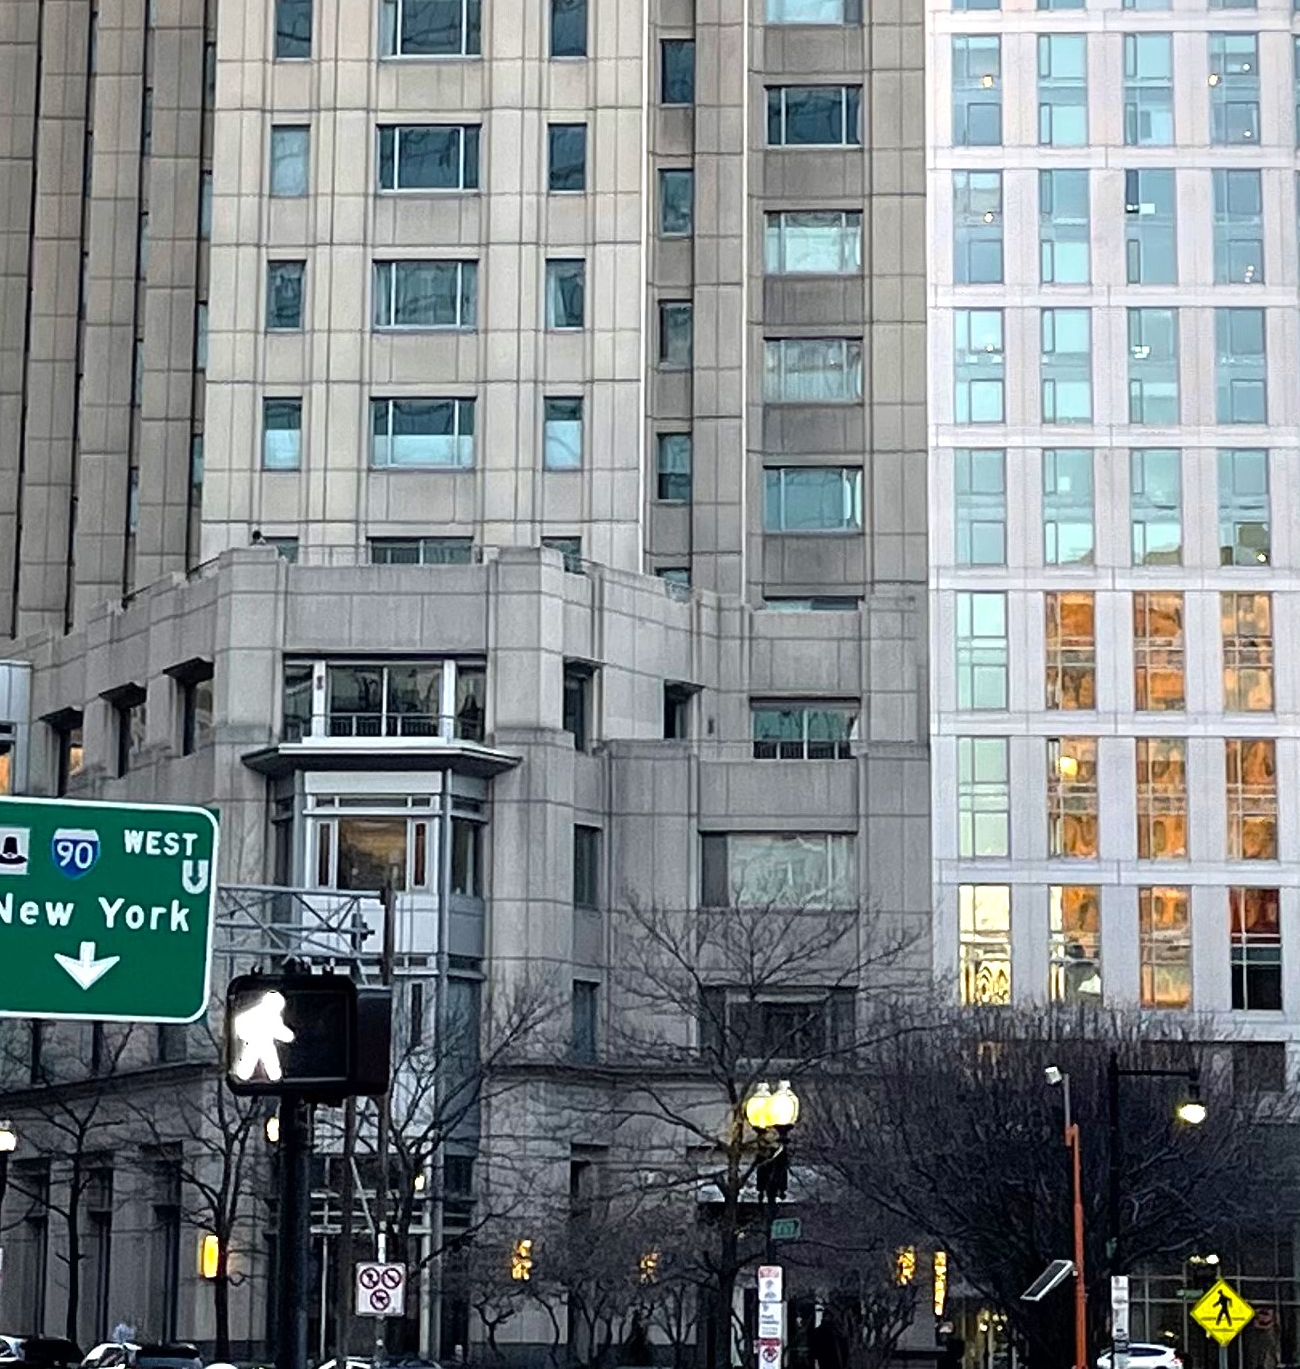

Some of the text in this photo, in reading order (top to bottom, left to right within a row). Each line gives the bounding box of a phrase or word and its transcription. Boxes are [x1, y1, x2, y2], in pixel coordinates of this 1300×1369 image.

[57, 829, 198, 869] 90 WEST
[98, 896, 189, 932] York
